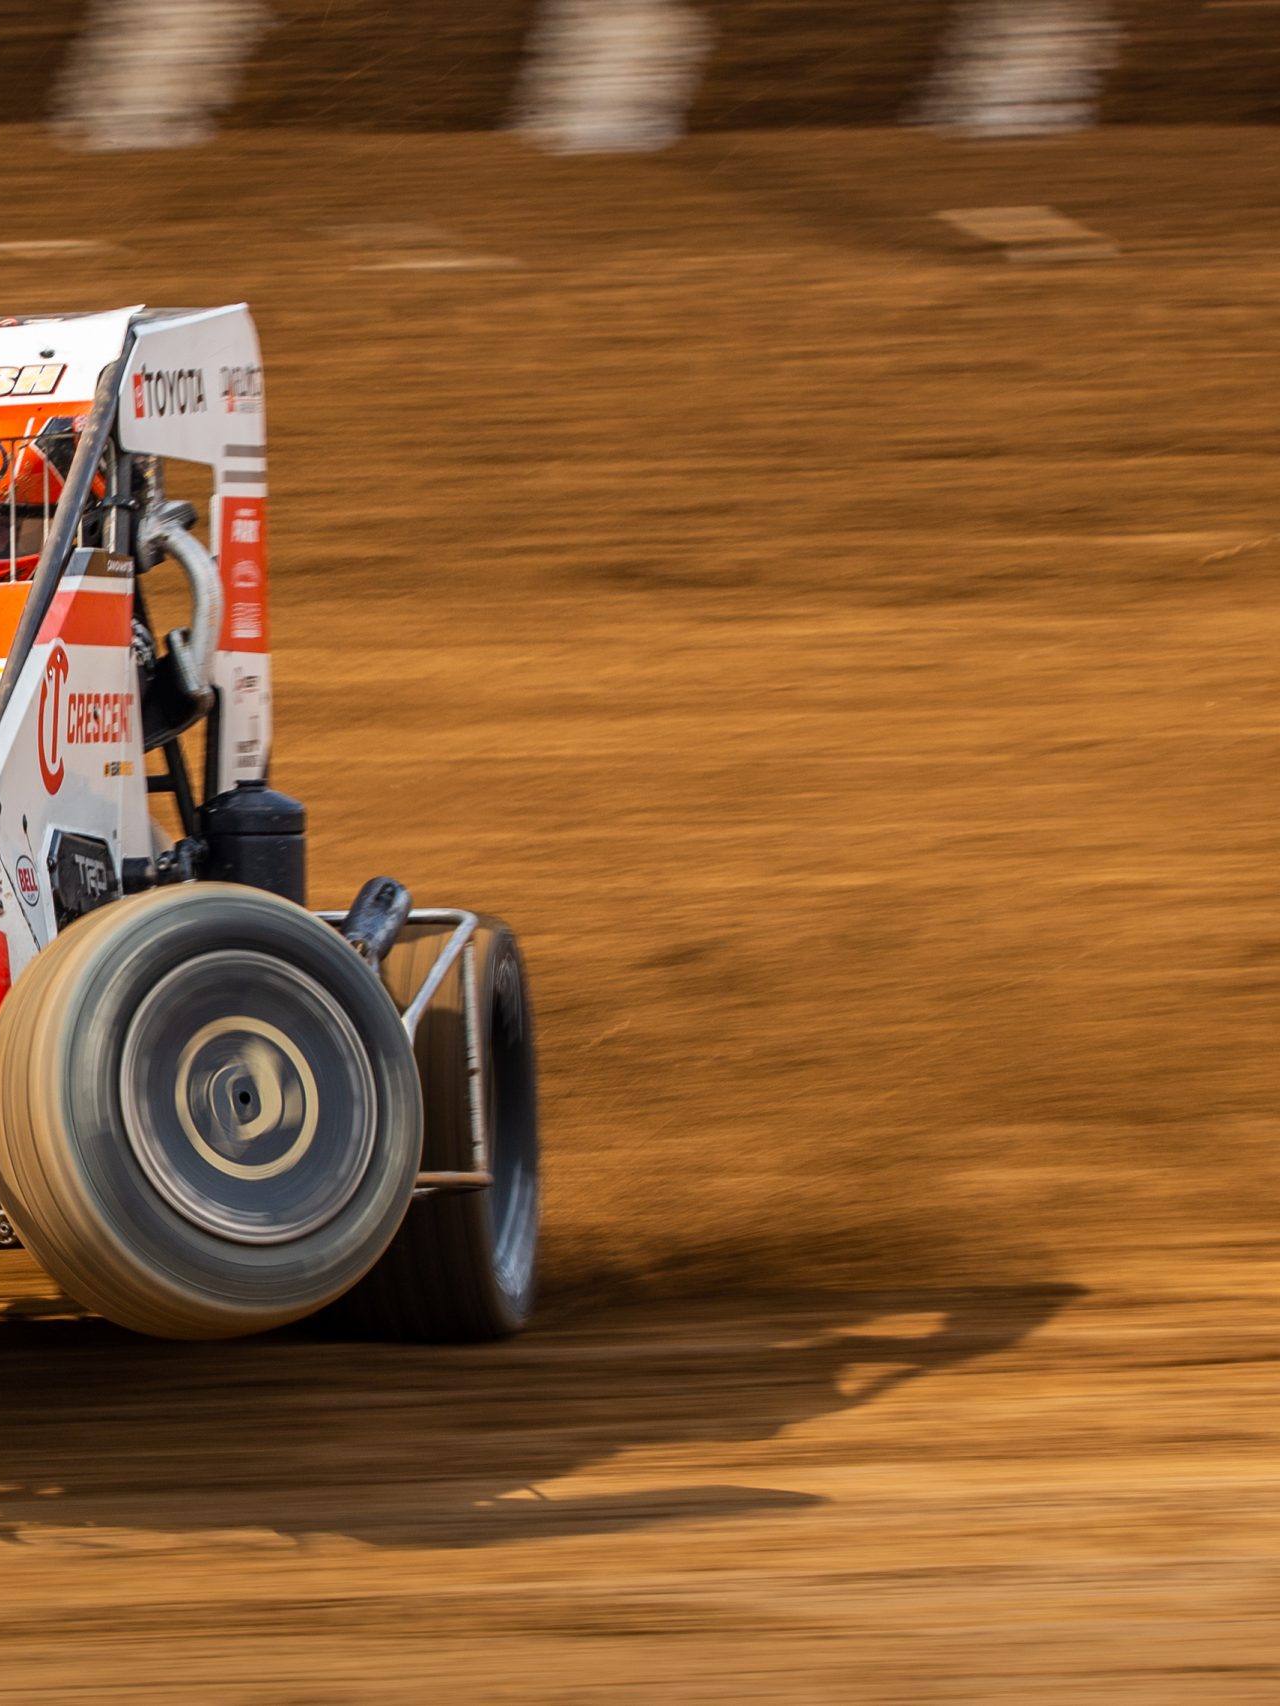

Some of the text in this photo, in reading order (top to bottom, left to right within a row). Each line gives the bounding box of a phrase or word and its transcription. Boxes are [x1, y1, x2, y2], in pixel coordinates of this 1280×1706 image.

[144, 367, 207, 418] TOYOTA
[67, 694, 135, 743] CRESCENT
[18, 867, 39, 893] BELL
